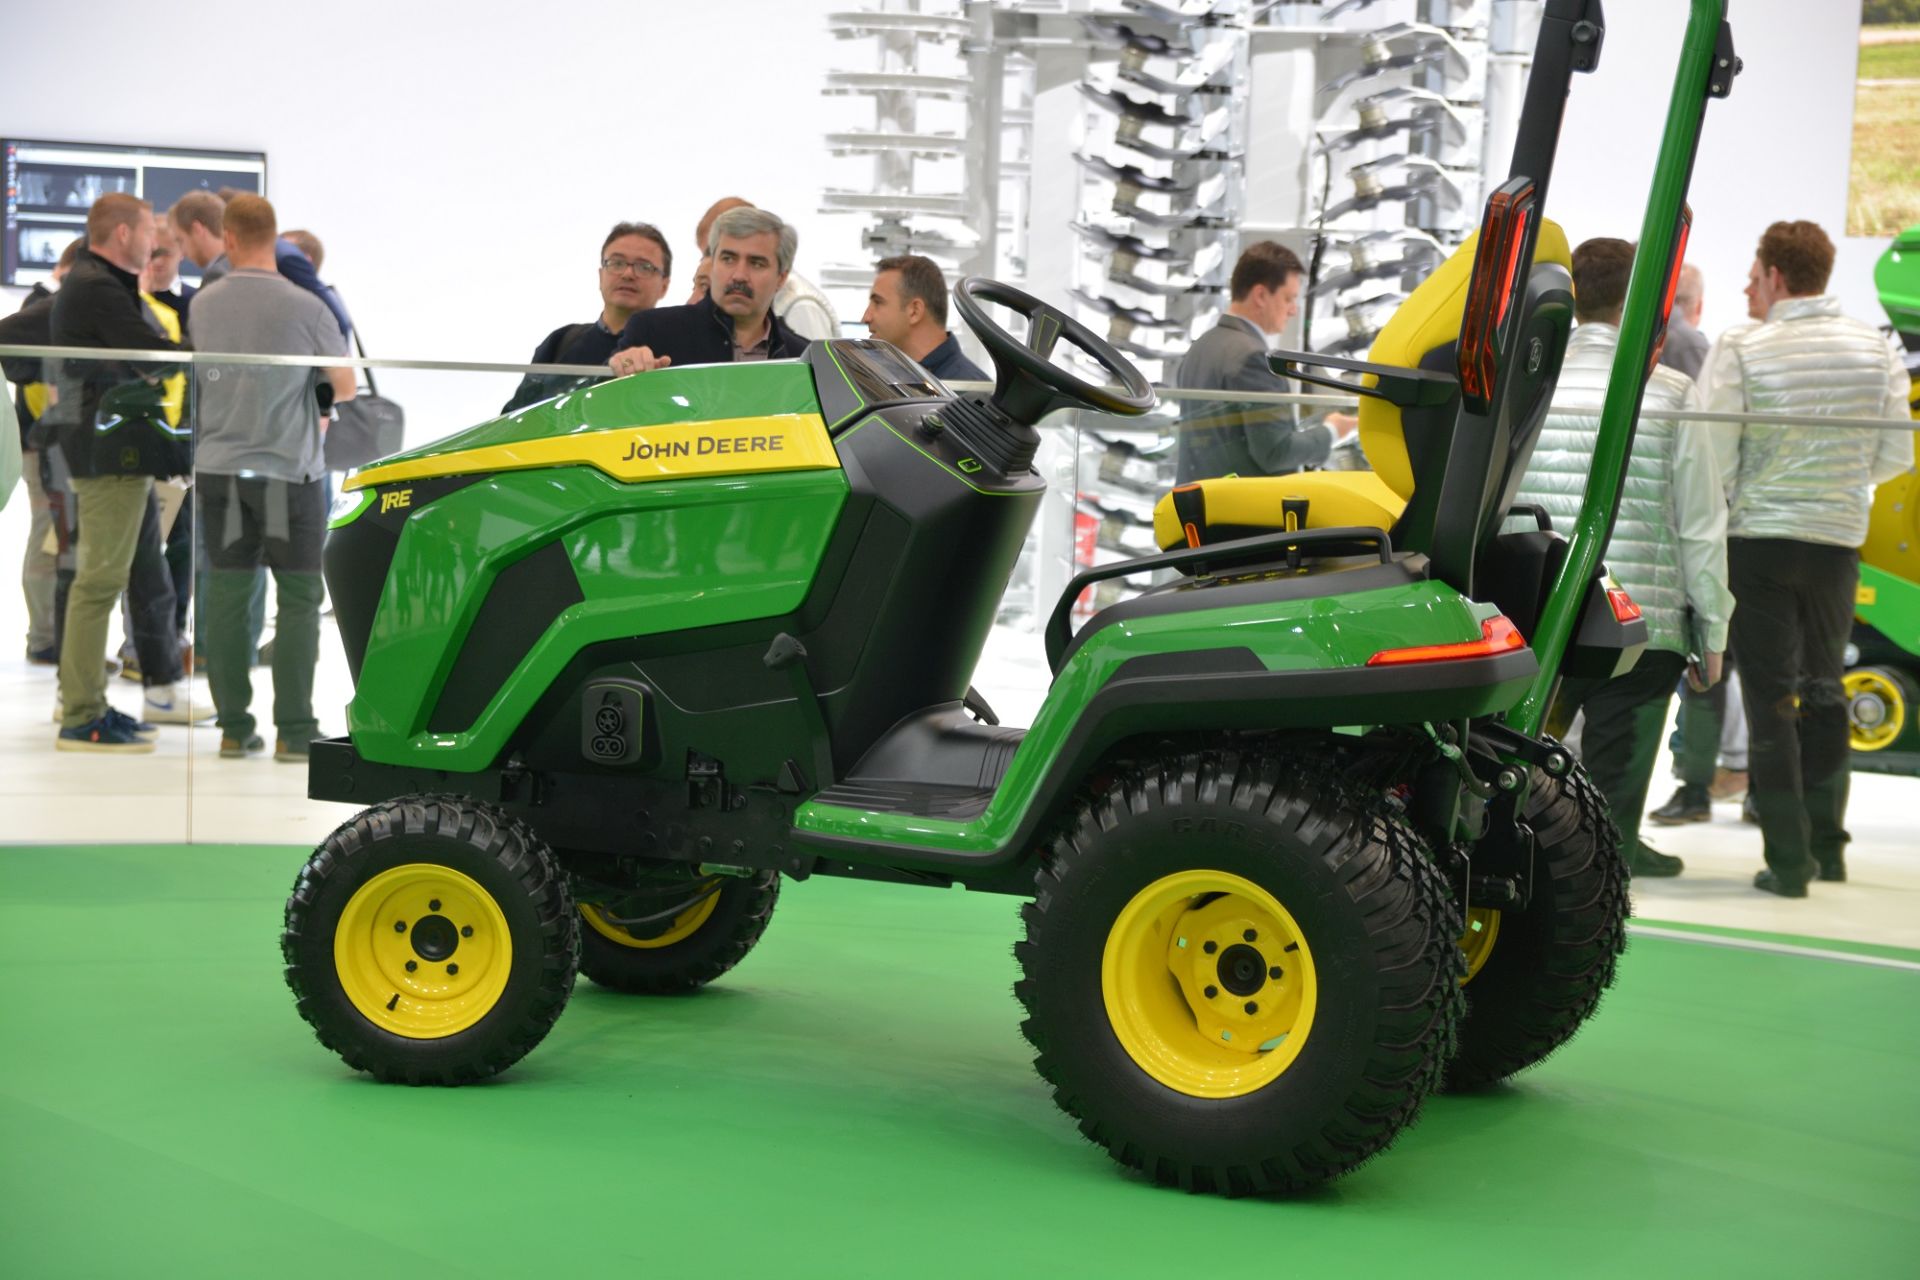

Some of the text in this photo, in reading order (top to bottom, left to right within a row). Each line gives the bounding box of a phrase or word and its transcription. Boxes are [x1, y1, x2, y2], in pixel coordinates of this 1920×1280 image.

[622, 435, 784, 462] JOHN DEERE
[381, 489, 413, 514] 1RE
